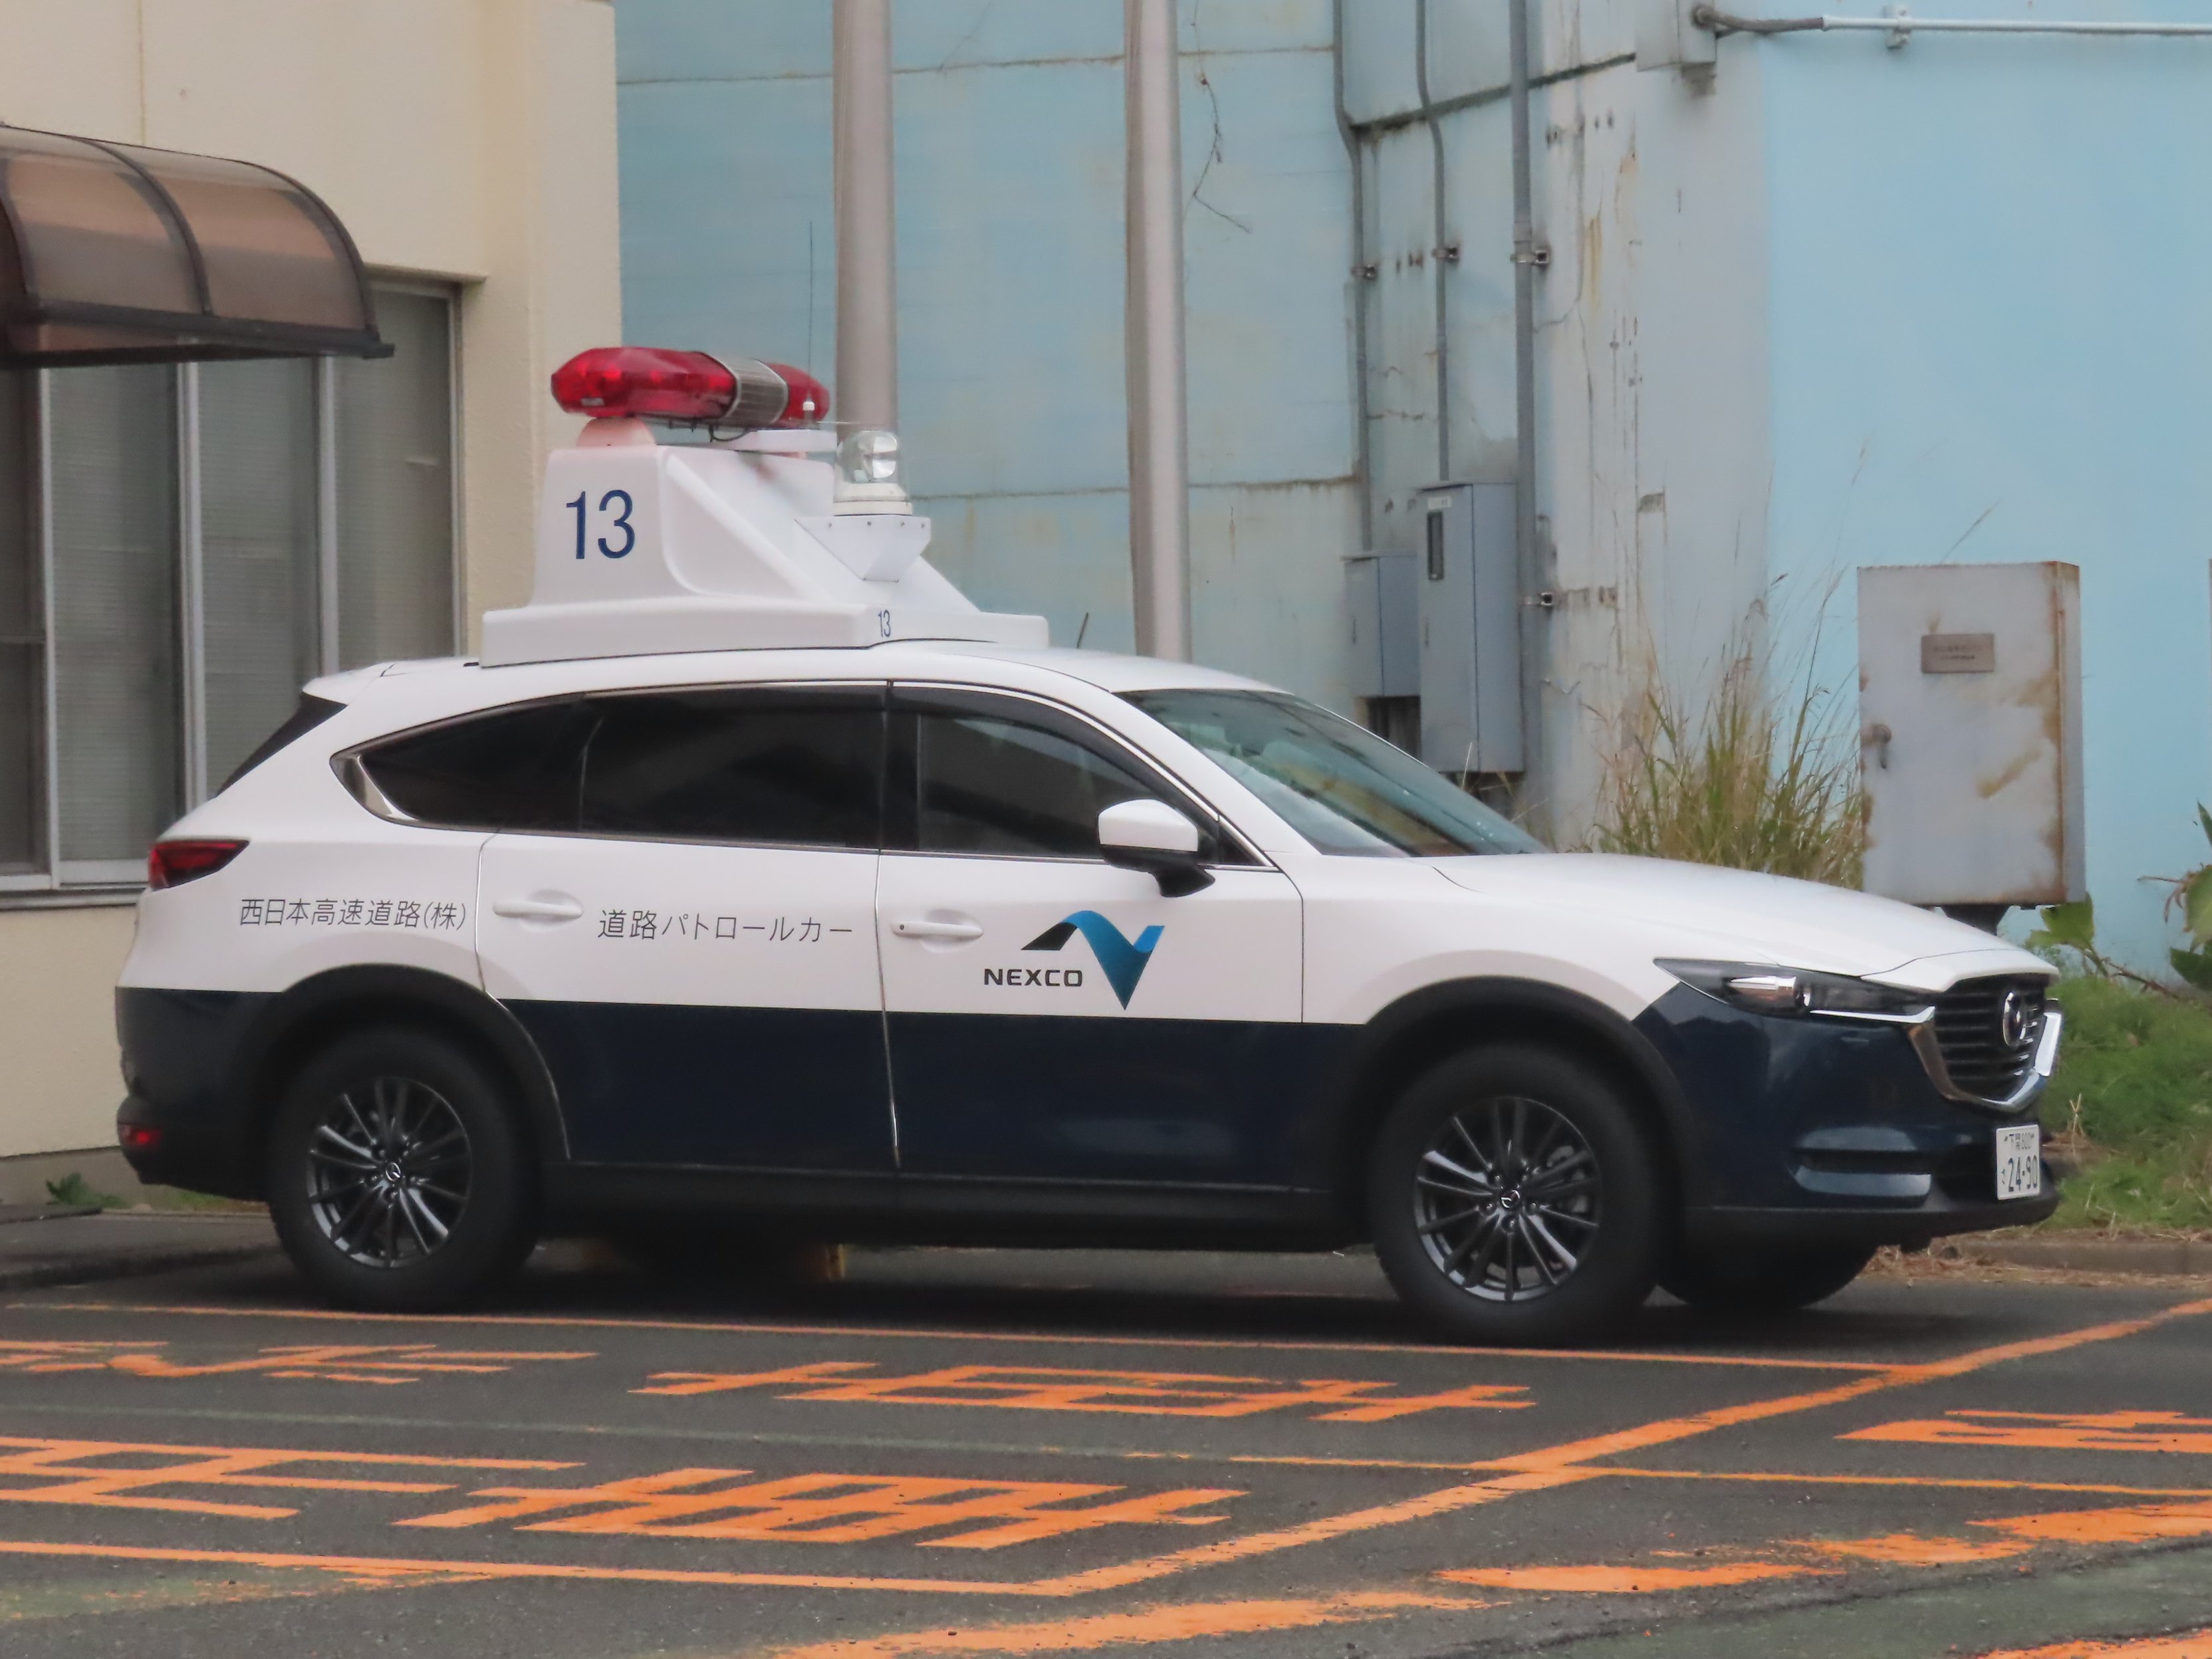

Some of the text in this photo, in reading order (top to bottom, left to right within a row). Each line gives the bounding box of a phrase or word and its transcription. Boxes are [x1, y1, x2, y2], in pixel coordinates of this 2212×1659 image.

[566, 489, 635, 559] 13
[877, 610, 892, 638] 13
[240, 898, 467, 931] 西日本高速道路(株)
[598, 909, 852, 942] 道路パトロールカー
[984, 968, 1083, 987] NEXCO
[2008, 1154, 2038, 1192] 24-90
